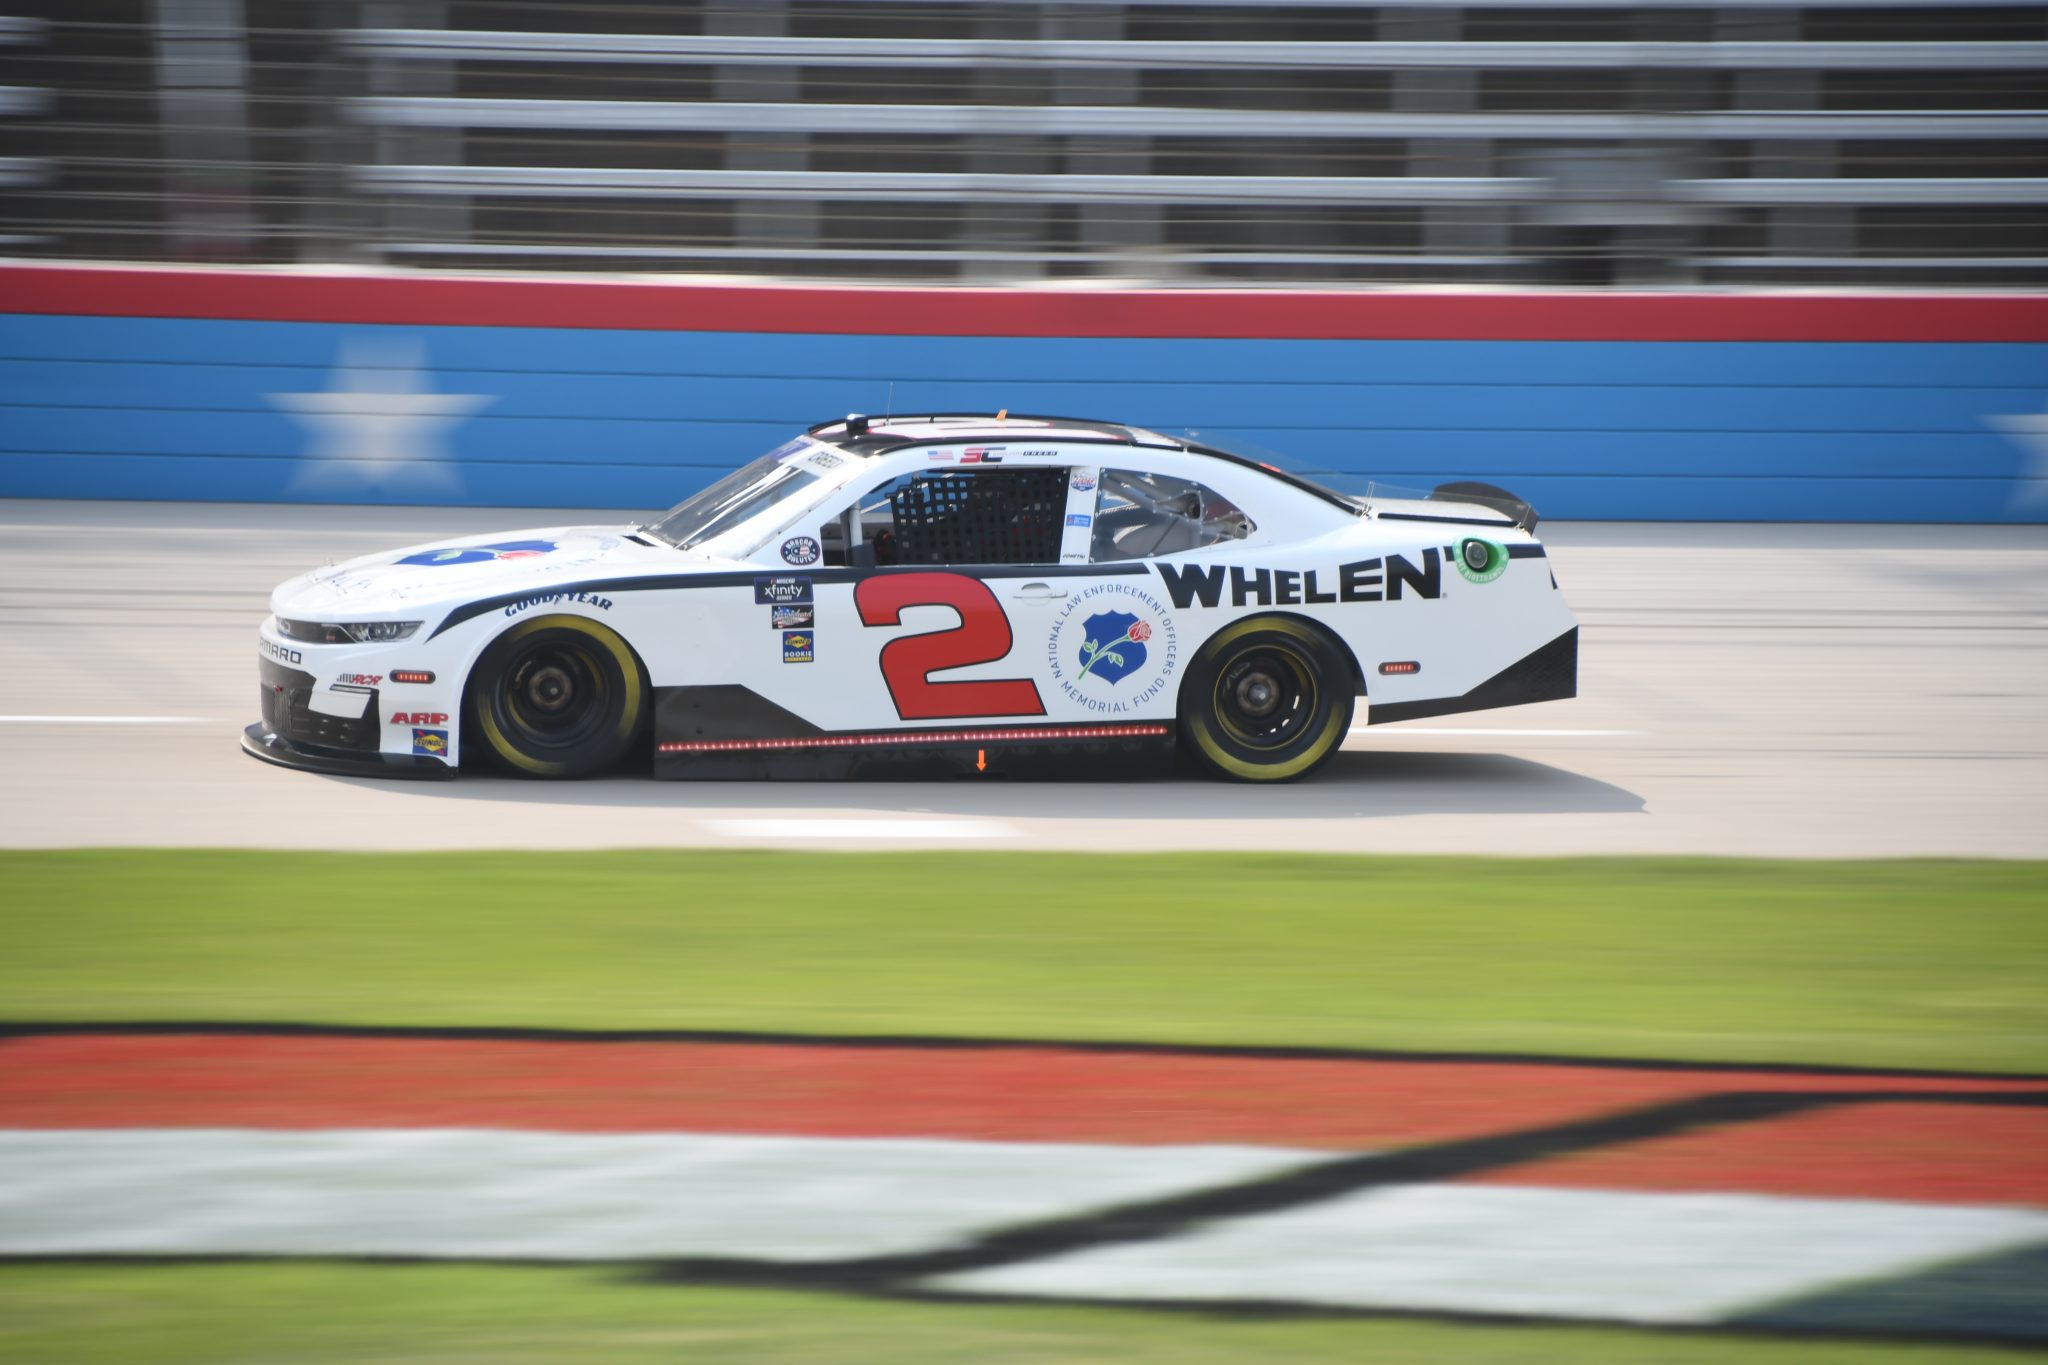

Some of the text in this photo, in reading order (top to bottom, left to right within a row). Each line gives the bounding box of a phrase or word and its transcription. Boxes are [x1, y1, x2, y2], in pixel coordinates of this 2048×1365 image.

[785, 536, 814, 549] NASCAR
[786, 553, 817, 564] SALUTES
[765, 584, 803, 599] xfinity
[1154, 547, 1443, 609] WHELEN
[505, 589, 614, 617] GOODYEAR
[1048, 584, 1177, 679] NATIONAL LAW ENFORCEMENT OFFICERS
[853, 572, 1048, 721] 2
[1060, 677, 1166, 713] MEMORIAL FUND
[389, 712, 449, 725] ARP
